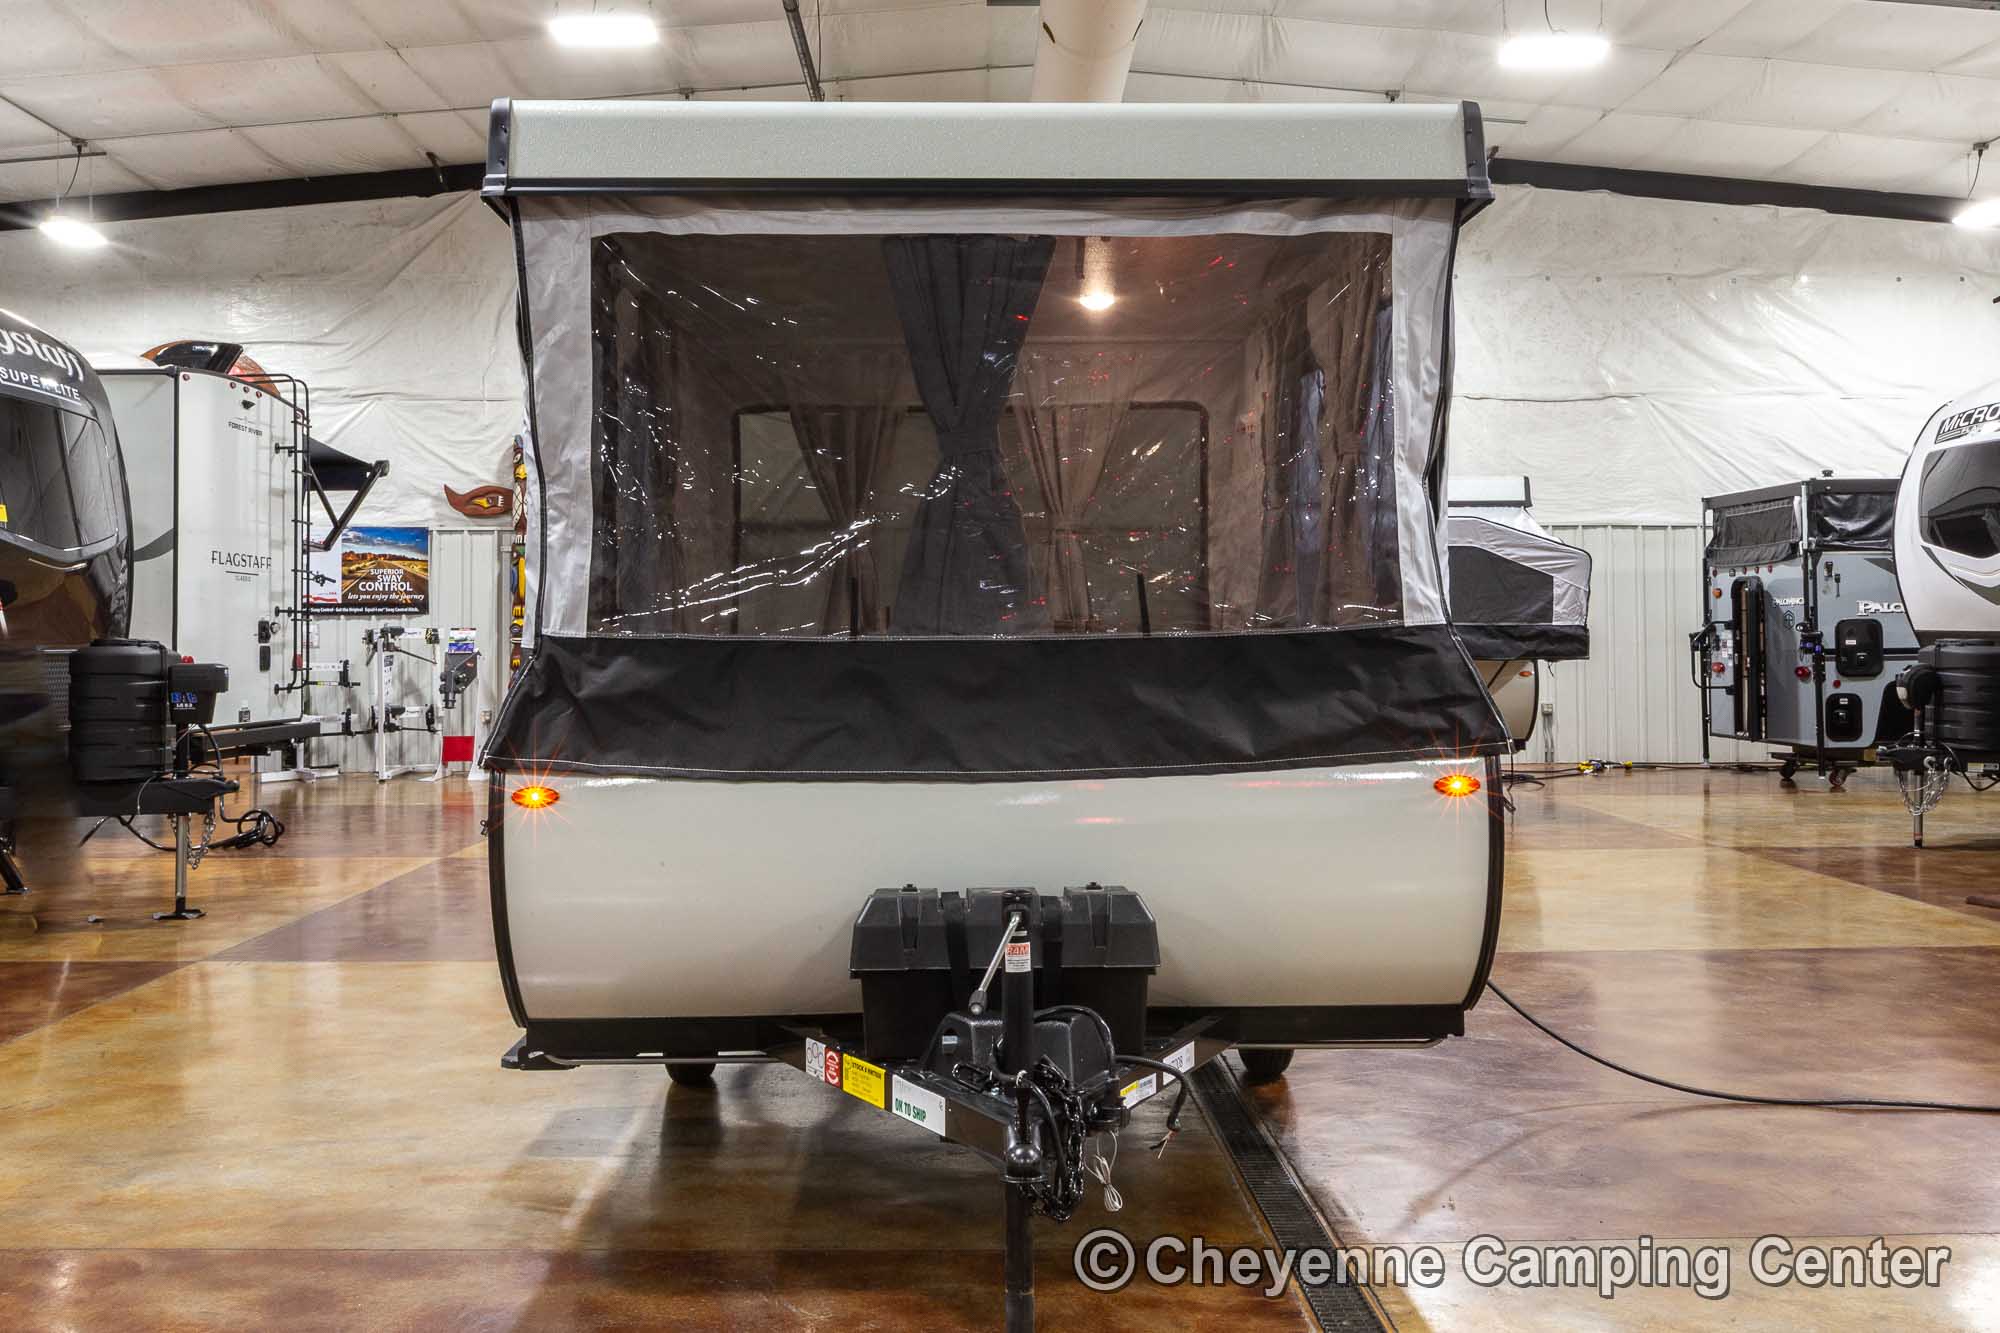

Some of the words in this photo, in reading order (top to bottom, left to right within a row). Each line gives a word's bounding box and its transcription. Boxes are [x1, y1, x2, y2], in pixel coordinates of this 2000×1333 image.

[211, 550, 272, 569] FLAGSTAFF
[358, 581, 413, 591] CONTROL
[348, 592, 358, 600] lets
[359, 594, 371, 602] you
[371, 593, 388, 602] enjoy
[389, 592, 399, 600] the
[895, 1098, 903, 1112] OK
[904, 1102, 911, 1116] TO
[912, 1105, 926, 1122] SHIP
